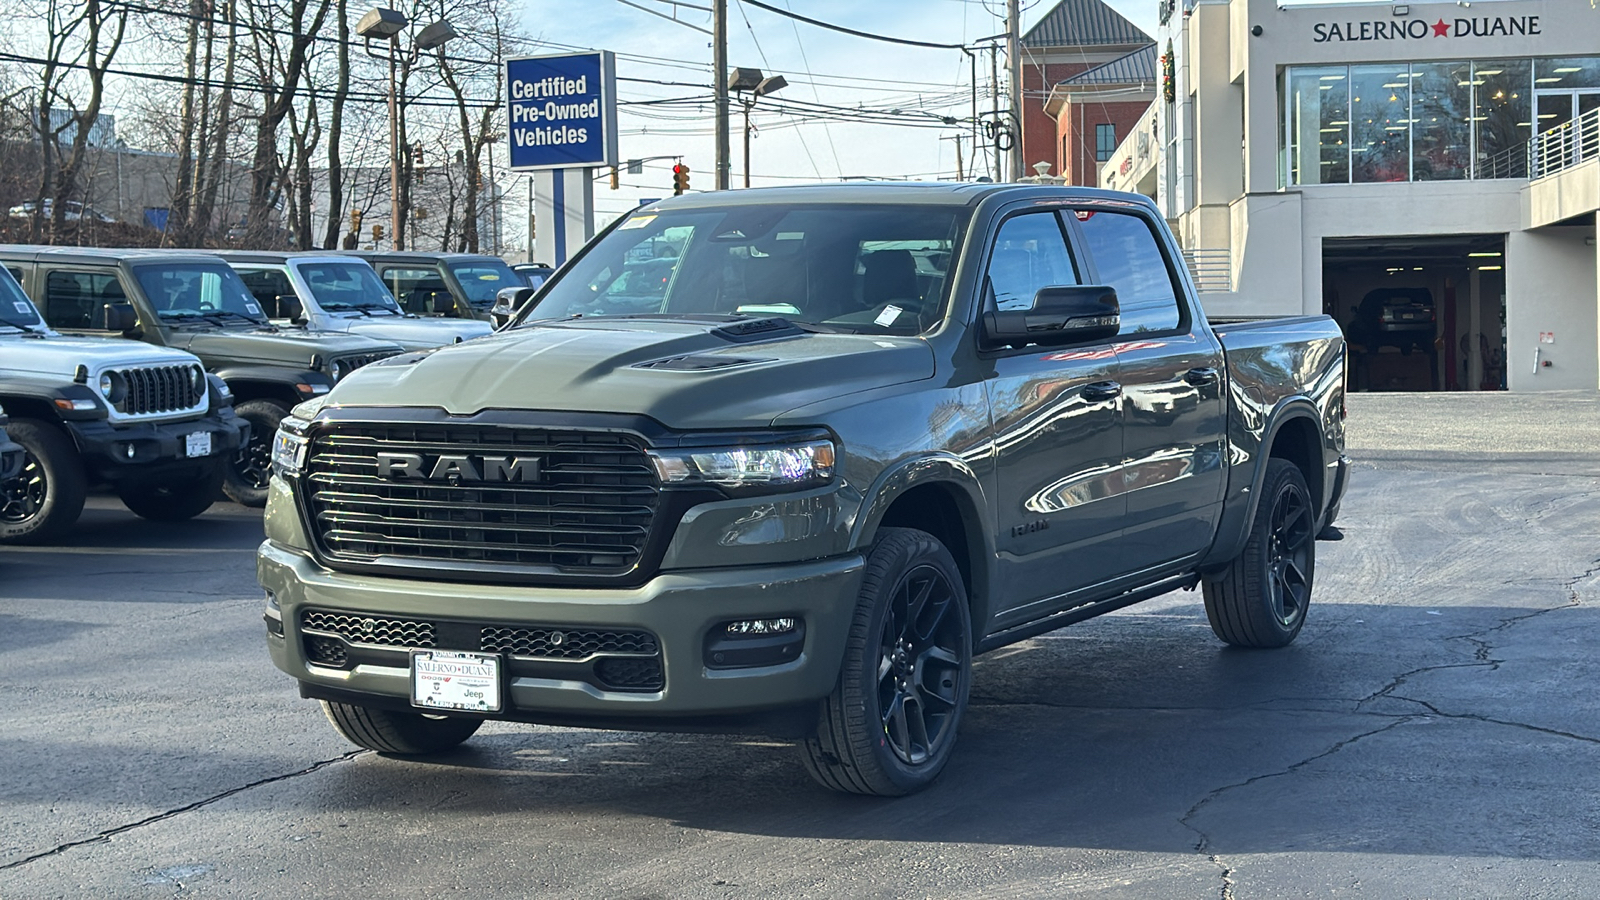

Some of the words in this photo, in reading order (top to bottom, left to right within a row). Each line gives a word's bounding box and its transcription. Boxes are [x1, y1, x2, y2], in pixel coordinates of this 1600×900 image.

[1313, 19, 1428, 42] SALERNO
[1454, 16, 1541, 38] DUANE
[512, 75, 587, 98] Certified
[512, 98, 599, 123] Pre-Owned
[513, 125, 588, 147] Vehicles
[377, 451, 541, 482] RAM
[1011, 518, 1049, 538] RAM
[417, 661, 457, 674] SALERNO
[461, 665, 494, 677] DUANE
[464, 689, 484, 699] Jeep
